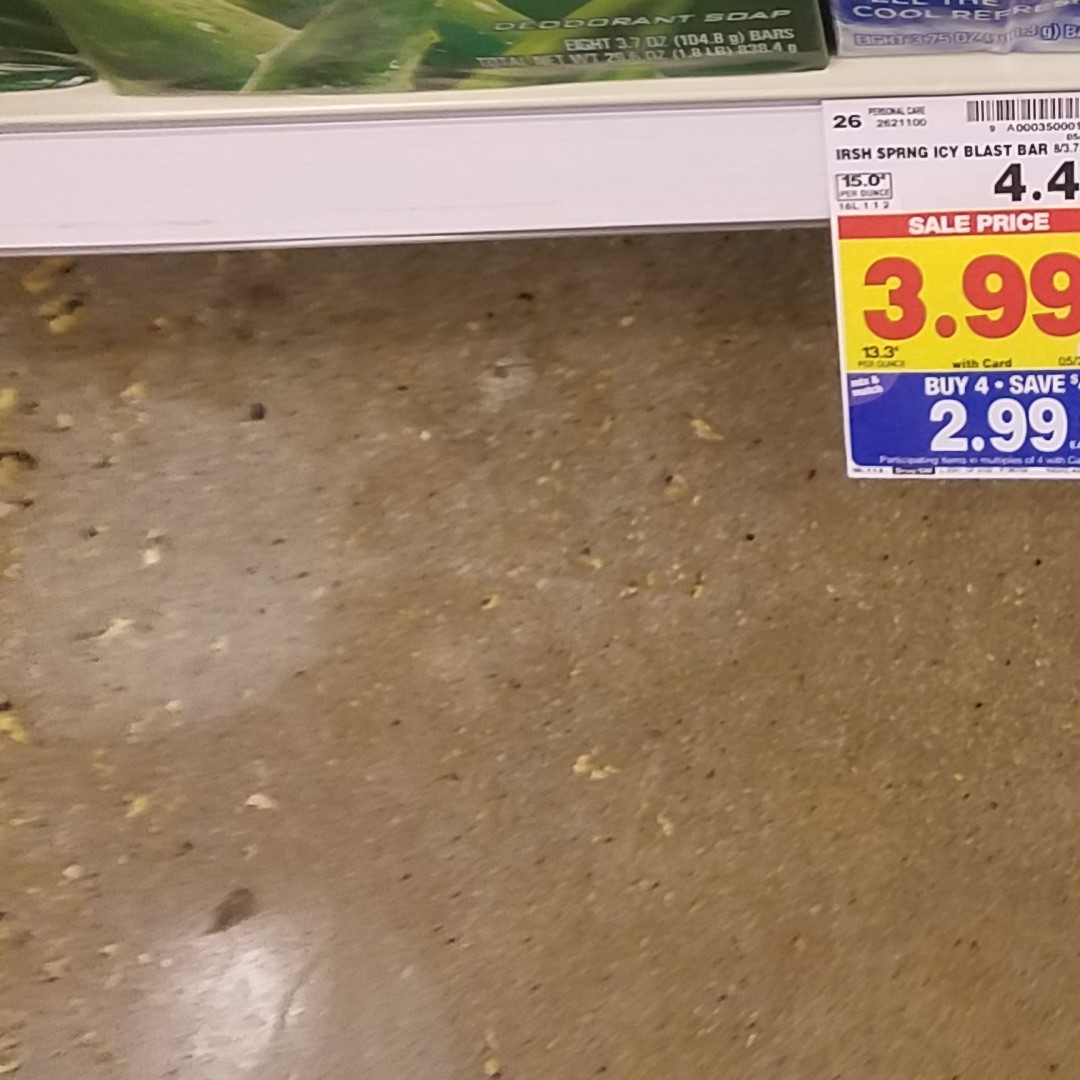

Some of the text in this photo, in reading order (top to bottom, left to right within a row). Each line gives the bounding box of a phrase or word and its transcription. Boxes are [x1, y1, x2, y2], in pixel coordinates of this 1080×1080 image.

[703, 8, 793, 23] SOAP
[852, 6, 943, 21] COOL
[728, 30, 745, 46] g)
[749, 28, 796, 42] BARS
[1042, 23, 1060, 41] g)
[832, 114, 862, 129] 26
[835, 148, 872, 160] IRSH
[877, 146, 928, 159] SPRNG
[934, 145, 959, 158] ICY
[964, 145, 1012, 158] BLAST
[1017, 143, 1048, 156] BAR
[908, 212, 1051, 235] SALE PRICE
[952, 358, 1012, 369] with Card
[924, 376, 969, 396] BUY
[974, 376, 989, 395] 4
[1009, 374, 1066, 395] SAVE
[929, 397, 1069, 453] 2.99
